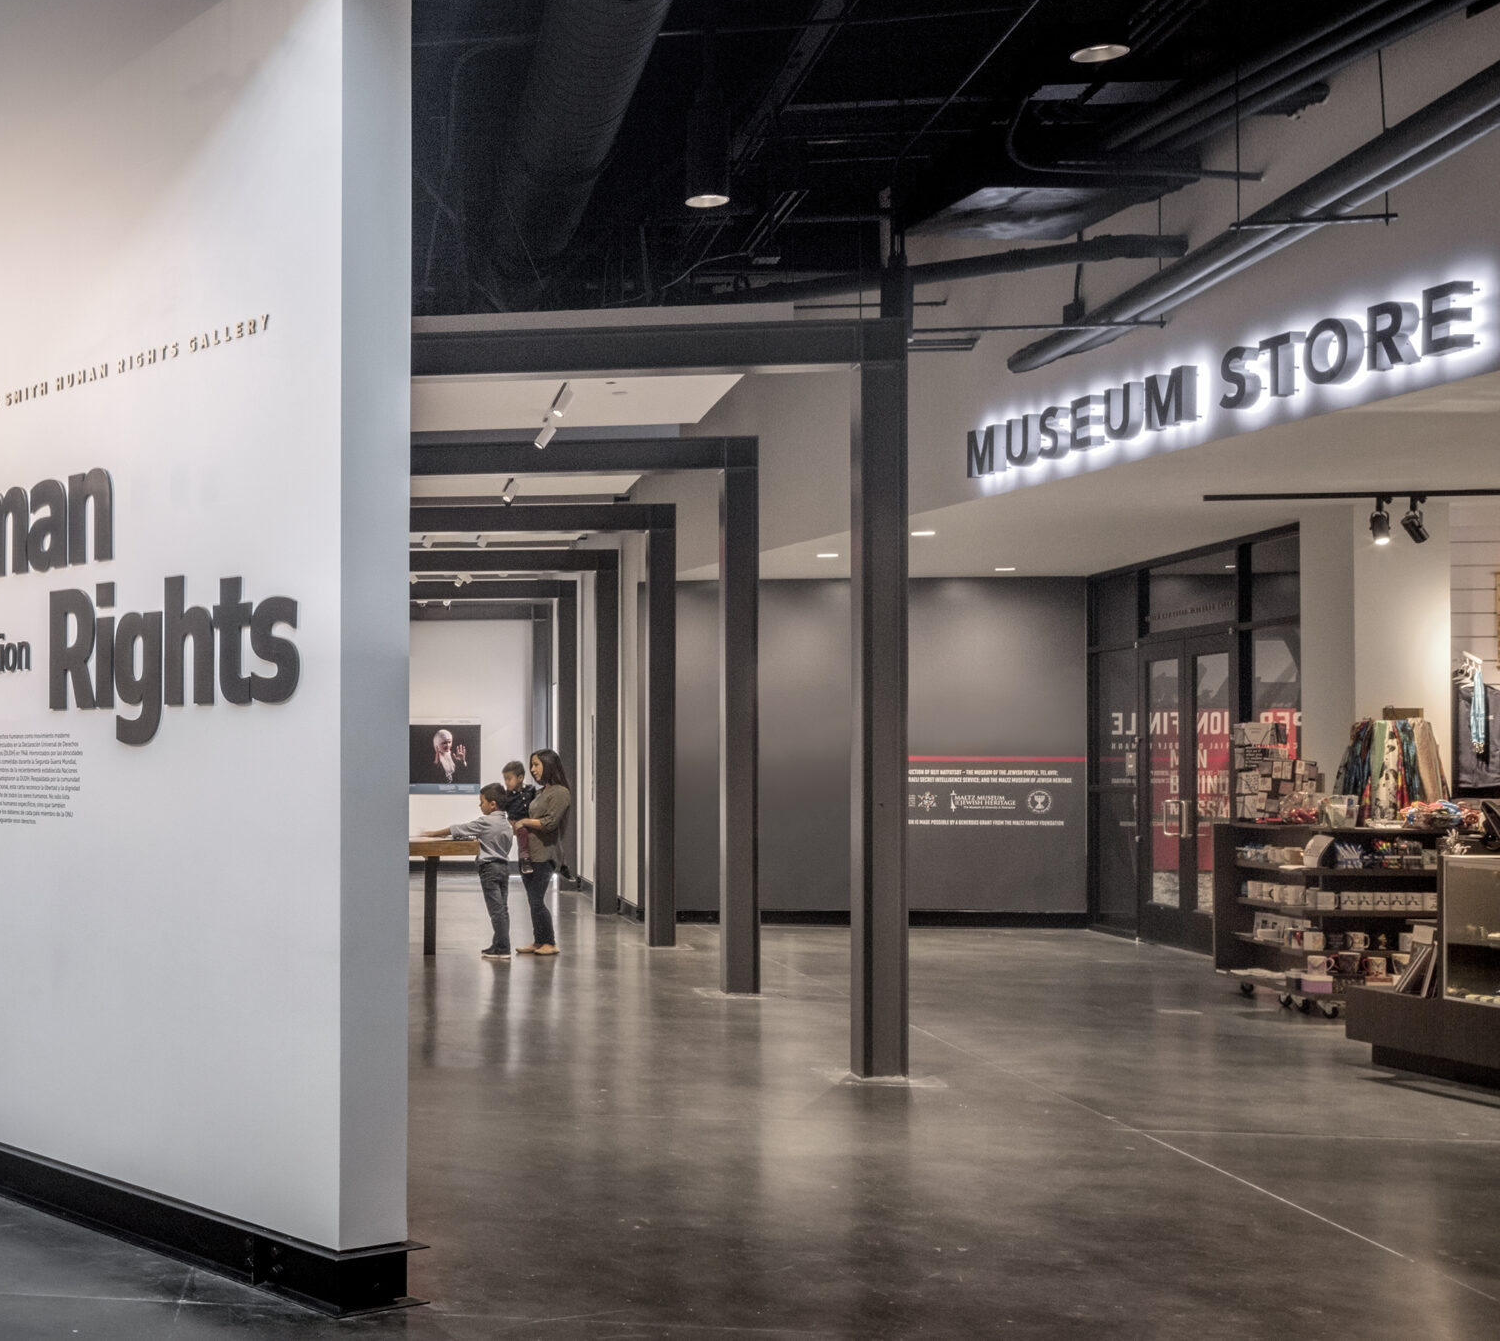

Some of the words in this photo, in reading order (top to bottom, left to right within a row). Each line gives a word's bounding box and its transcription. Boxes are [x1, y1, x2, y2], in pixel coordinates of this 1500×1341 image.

[5, 381, 49, 408] SMITH
[55, 363, 109, 392] HUMAN
[117, 341, 180, 374] RIGHTS
[189, 313, 271, 354] GALLERY
[966, 364, 1198, 479] MUSEUM
[1219, 280, 1480, 411] STORE
[49, 575, 300, 746] Rights
